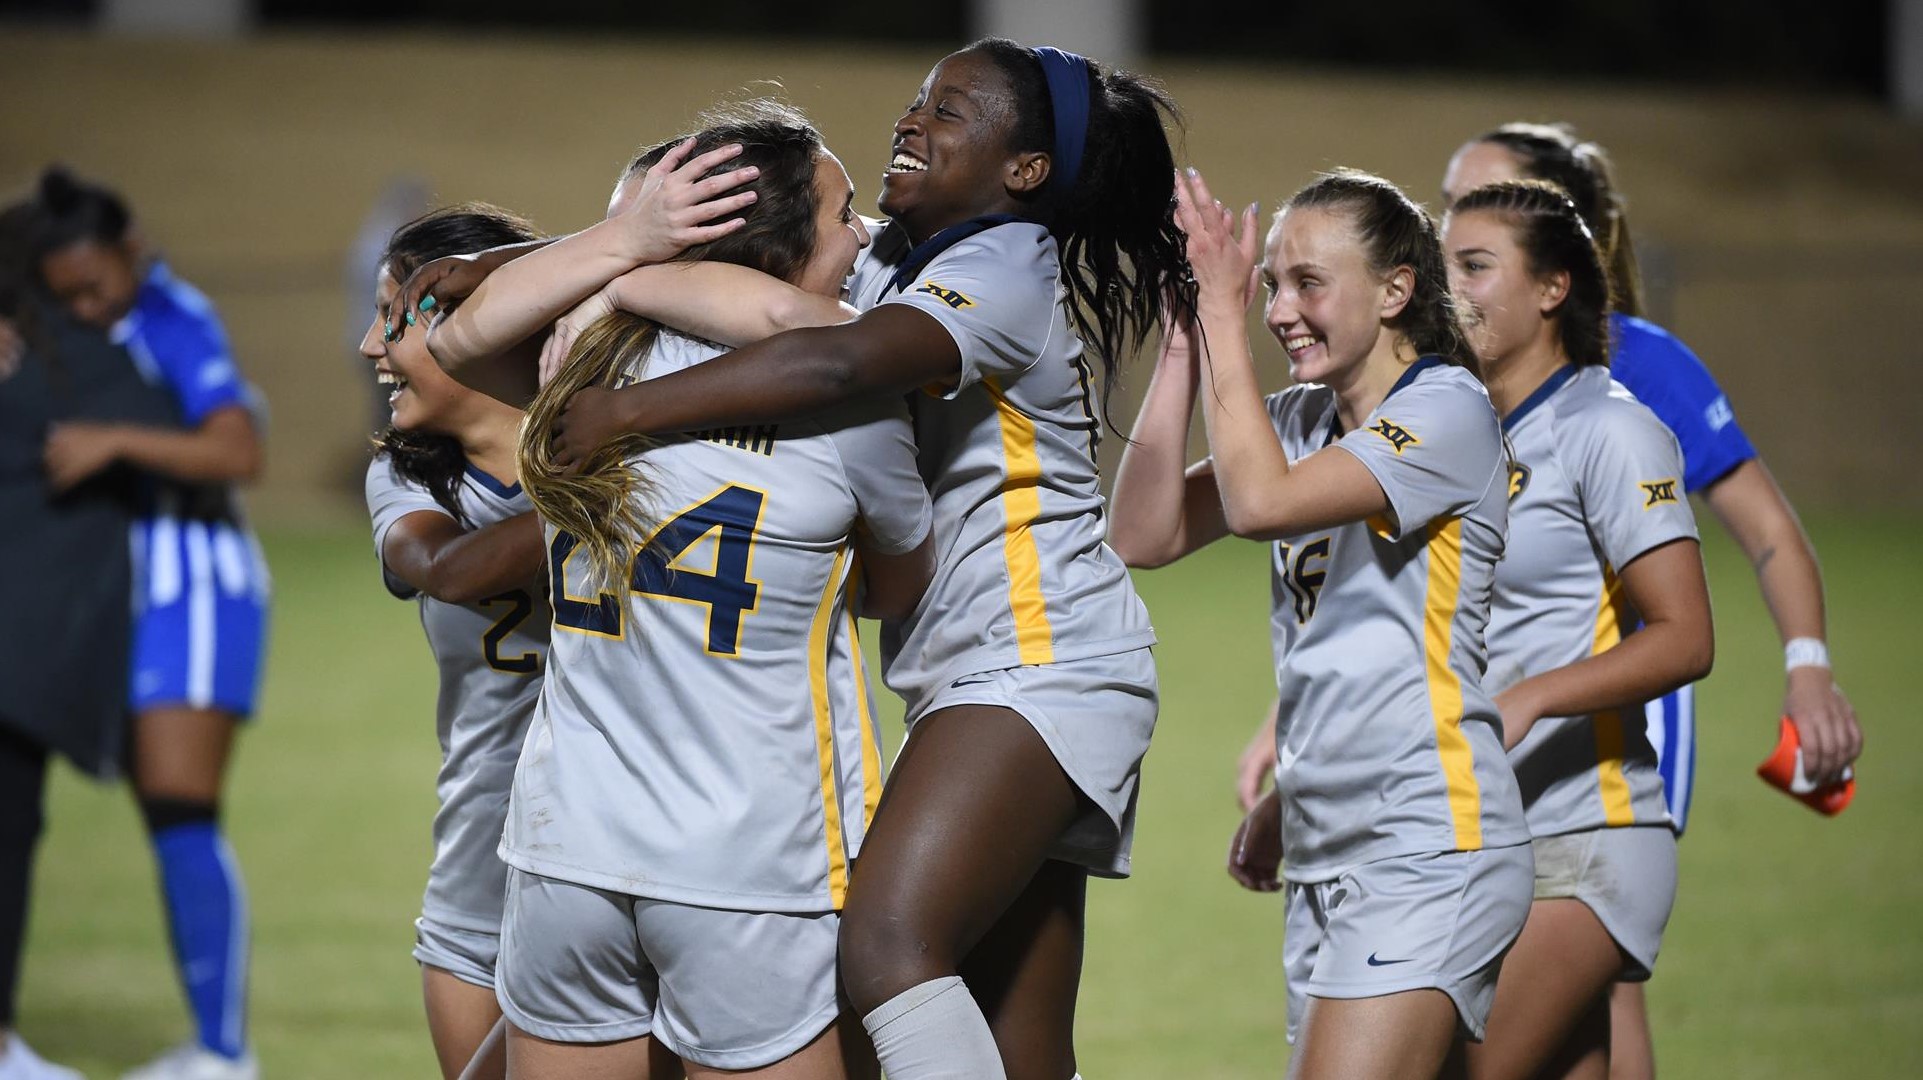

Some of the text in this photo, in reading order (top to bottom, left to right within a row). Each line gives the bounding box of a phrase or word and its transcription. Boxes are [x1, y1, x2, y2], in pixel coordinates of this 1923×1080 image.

[914, 281, 976, 311] XII
[1368, 417, 1420, 454] XII
[1638, 480, 1678, 510] XII
